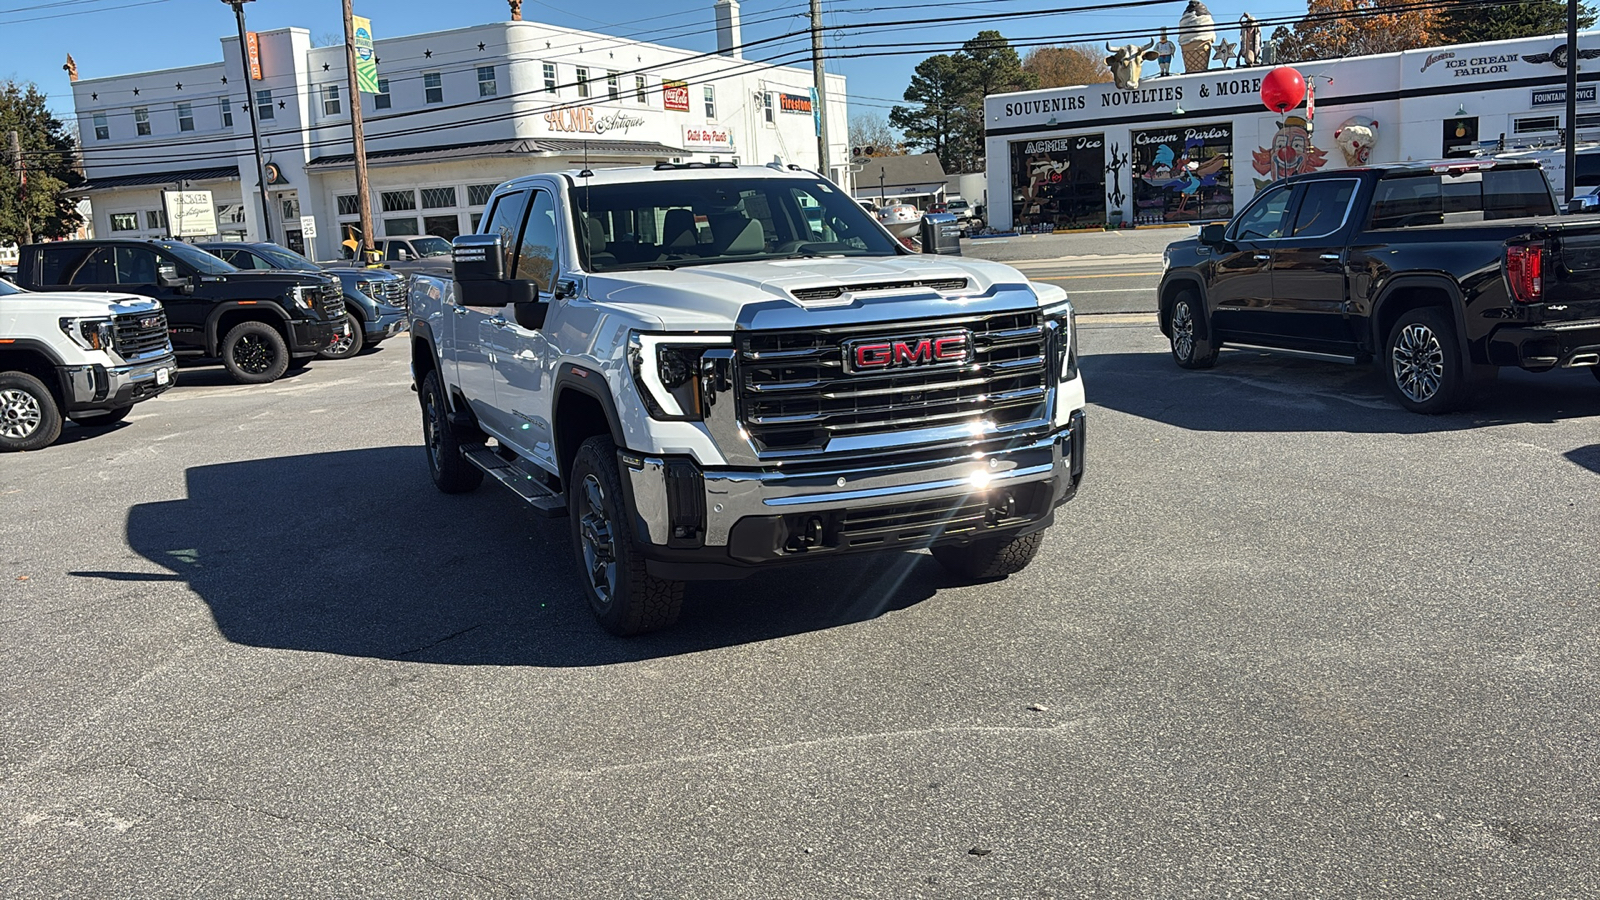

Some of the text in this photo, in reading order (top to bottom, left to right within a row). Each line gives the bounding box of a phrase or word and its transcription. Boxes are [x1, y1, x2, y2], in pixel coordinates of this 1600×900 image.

[249, 34, 259, 76] ACME
[1445, 54, 1519, 69] ICE CREAM
[1454, 64, 1509, 77] PARLOR
[780, 93, 811, 112] Firestone
[1005, 78, 1261, 117] SOUVENIRS NOVELTIES & MORE
[1534, 89, 1594, 103] FOUNTAIN RVICE
[544, 104, 645, 135] ACME Antiques
[687, 129, 727, 144] Dutch Boy Paints
[1025, 127, 1230, 154] ACME Ice Cream Parlor
[304, 226, 315, 236] 25
[855, 335, 967, 368] GMC
